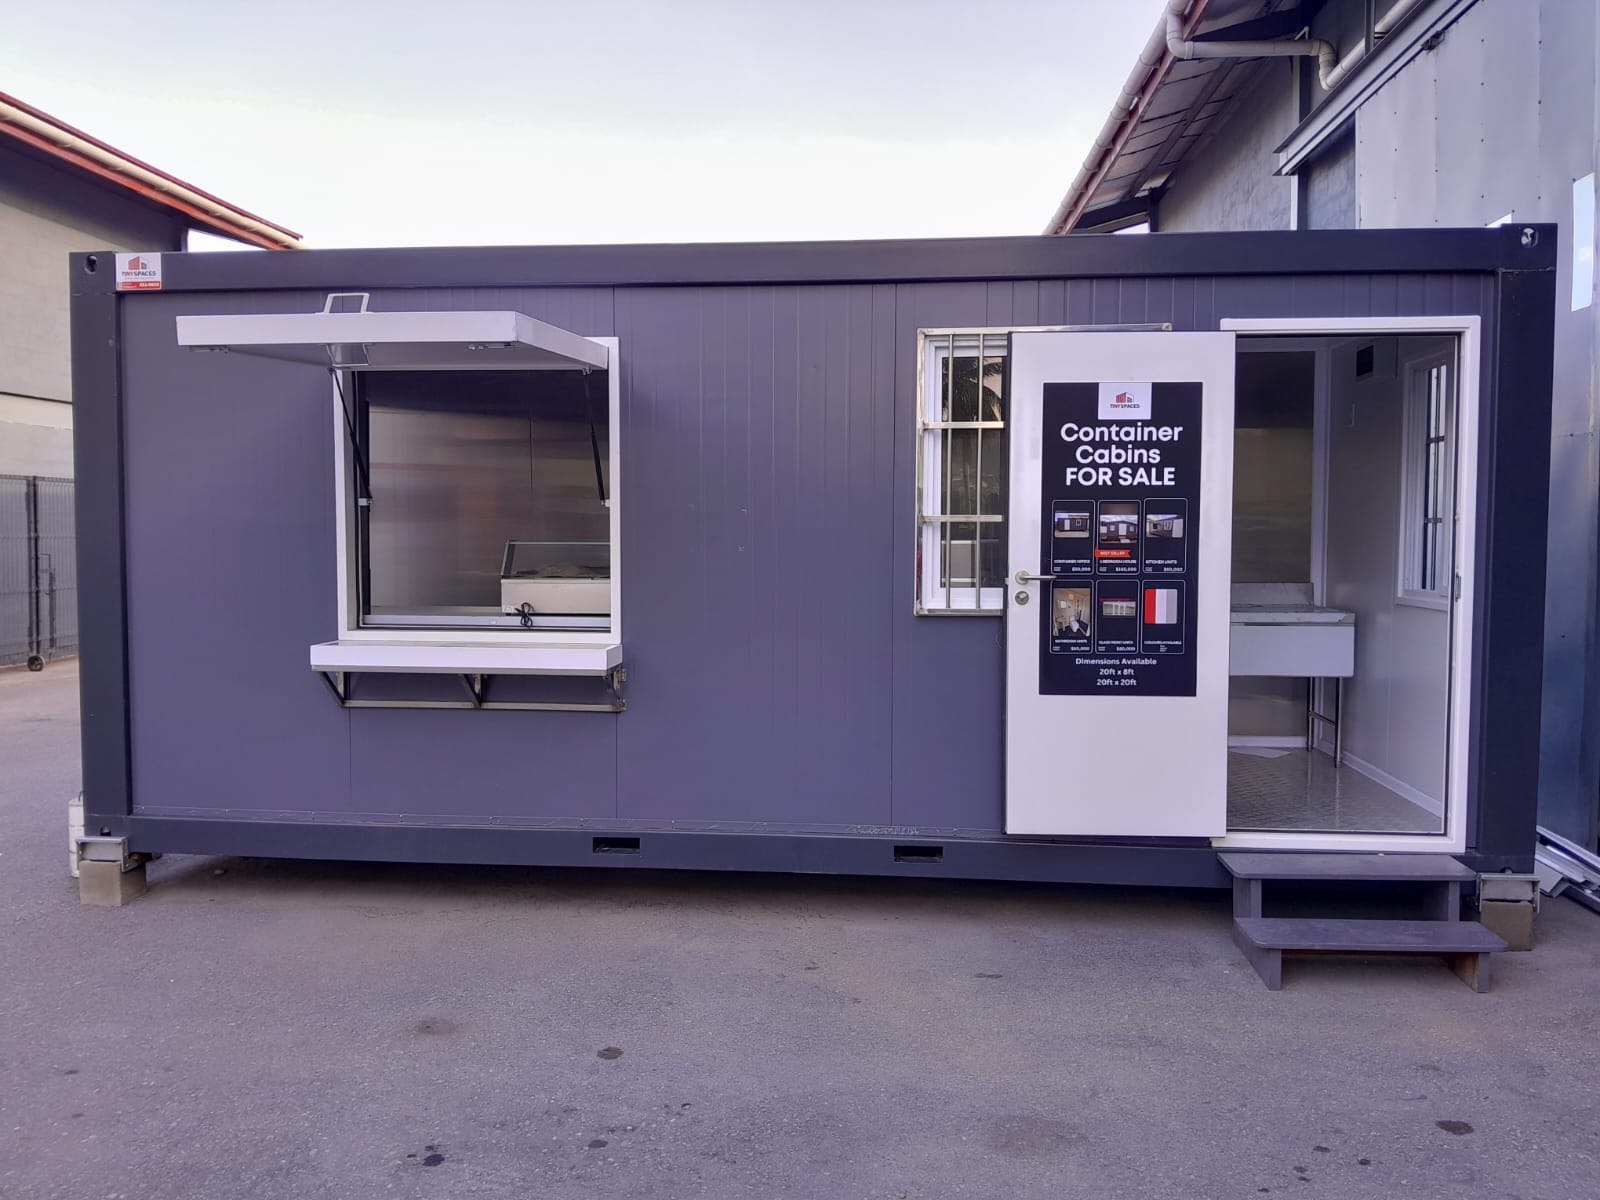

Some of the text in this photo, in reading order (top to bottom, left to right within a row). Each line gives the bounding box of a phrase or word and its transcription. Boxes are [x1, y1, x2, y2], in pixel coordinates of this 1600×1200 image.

[1060, 422, 1183, 442] Container
[1075, 444, 1161, 464] Cabins
[1065, 467, 1176, 486] FOR SALE
[1075, 657, 1158, 665] Dimensions Available
[1099, 668, 1116, 676] 20ft
[1096, 678, 1113, 686] 20ft
[1120, 678, 1137, 686] 20ft
